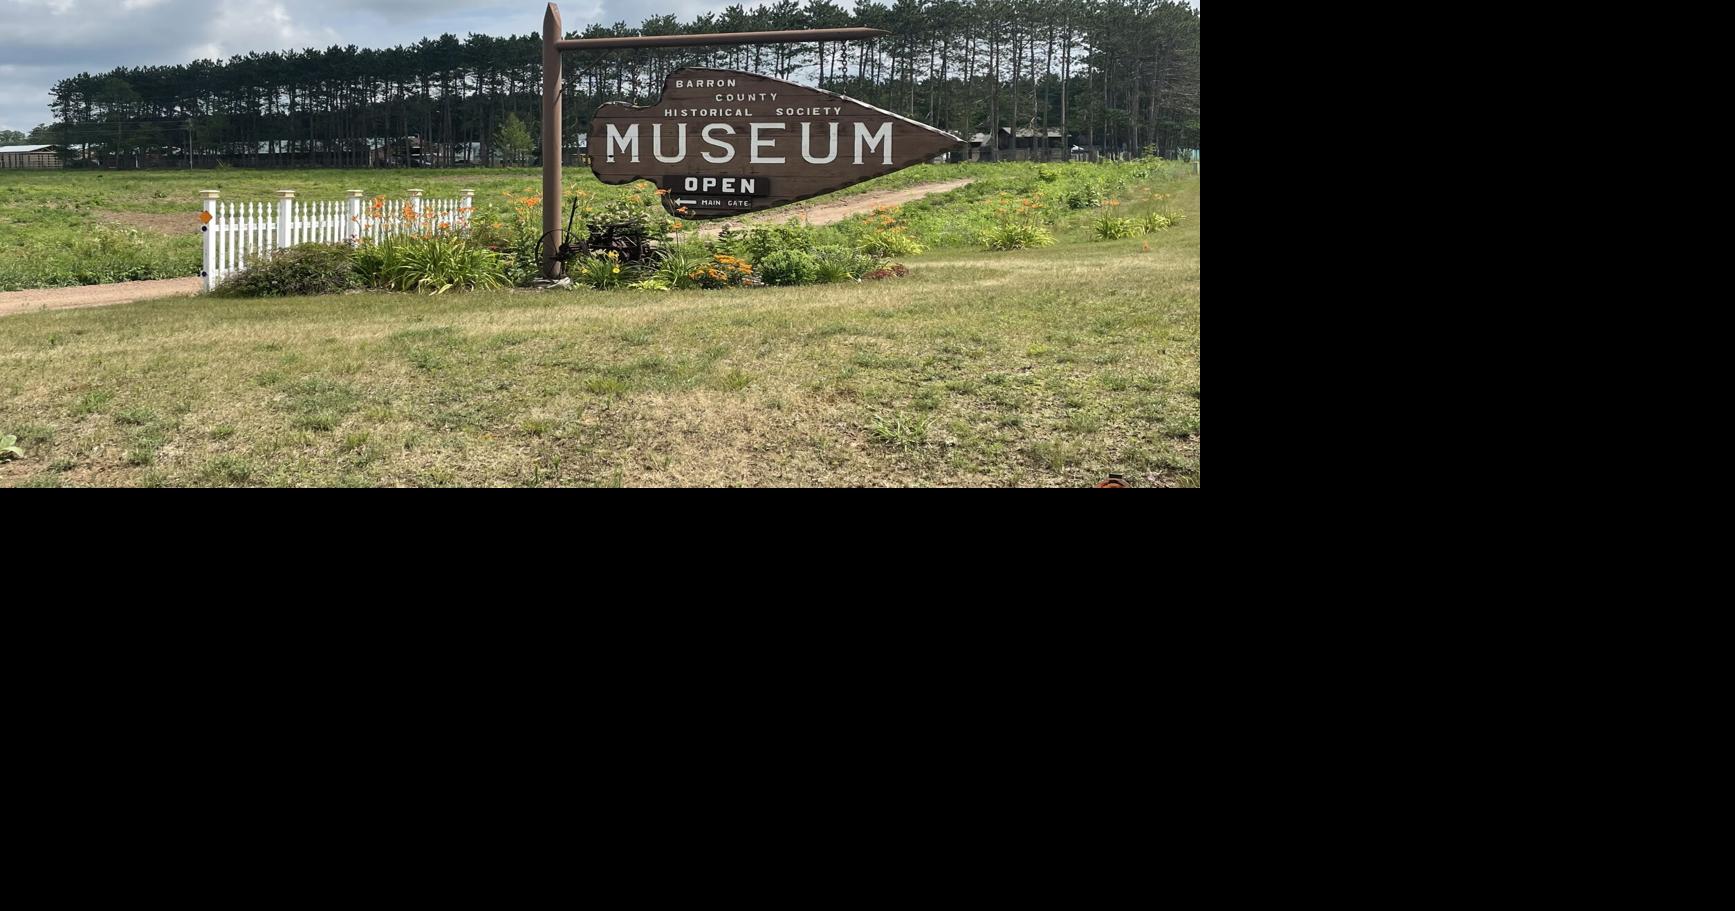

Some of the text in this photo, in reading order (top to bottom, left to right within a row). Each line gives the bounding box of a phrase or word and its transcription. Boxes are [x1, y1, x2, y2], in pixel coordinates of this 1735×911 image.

[676, 79, 736, 88] BARRON
[715, 93, 778, 102] COUNTY
[664, 107, 842, 117] HISTORICAL SOCIETY
[606, 122, 893, 164] MUSEUM
[684, 177, 755, 193] OPEN
